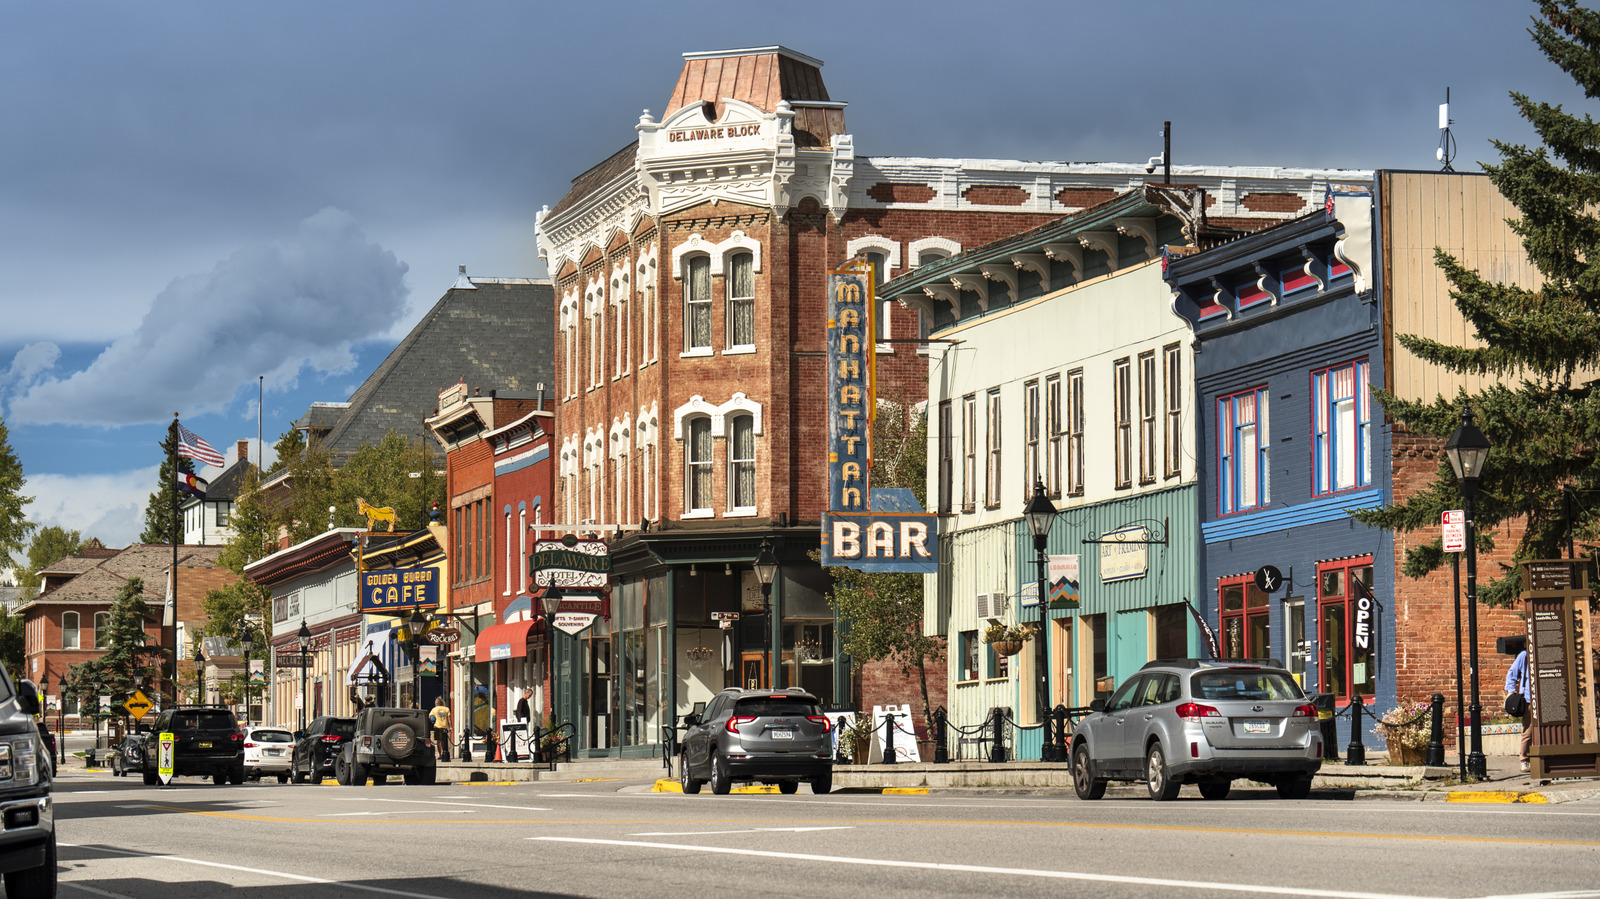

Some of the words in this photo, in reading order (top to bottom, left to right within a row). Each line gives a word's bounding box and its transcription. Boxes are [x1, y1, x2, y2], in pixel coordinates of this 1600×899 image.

[669, 128, 724, 142] DELAWARE
[728, 125, 760, 138] BLOCK
[838, 282, 860, 506] MANHATTAN
[1444, 514, 1448, 522] 4
[832, 521, 932, 558] BAR
[1101, 544, 1112, 558] ART
[532, 552, 610, 570] DELAWARE
[367, 574, 398, 586] GOLDEN
[403, 570, 432, 583] BURRO
[372, 585, 426, 604] CAFE
[1356, 598, 1370, 648] OPEN
[1572, 609, 1587, 698] LEADVILLE
[1528, 618, 1537, 719] INFORMATION
